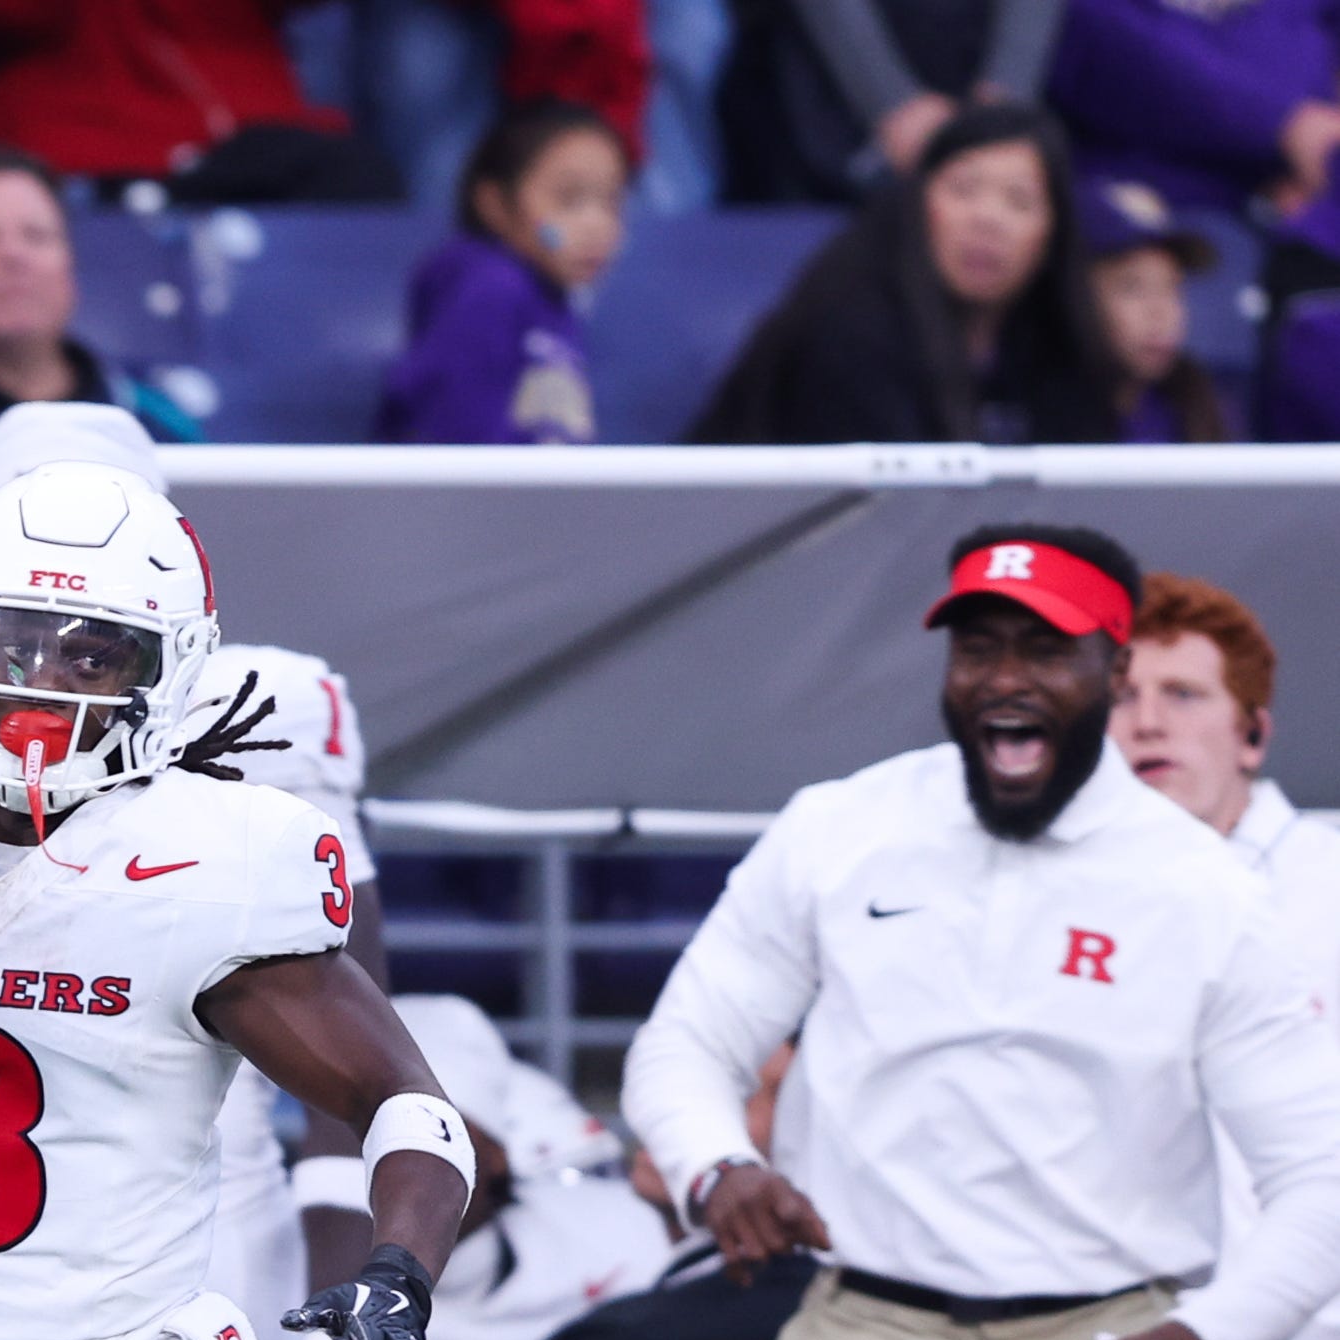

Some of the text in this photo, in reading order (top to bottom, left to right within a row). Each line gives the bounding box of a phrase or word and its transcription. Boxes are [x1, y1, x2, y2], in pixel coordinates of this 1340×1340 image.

[984, 544, 1035, 580] R
[315, 834, 352, 928] 3
[1060, 927, 1117, 984] R
